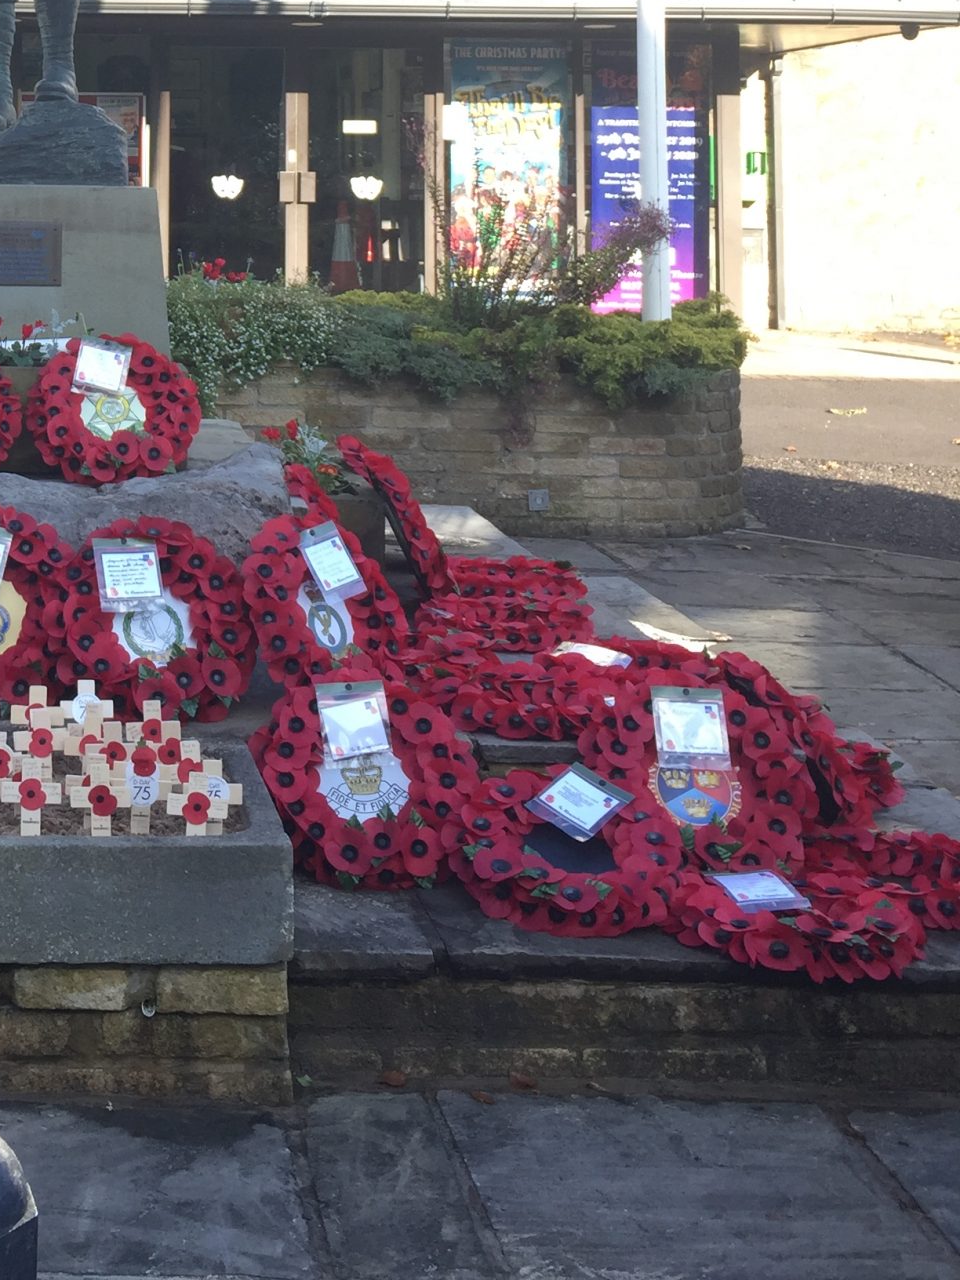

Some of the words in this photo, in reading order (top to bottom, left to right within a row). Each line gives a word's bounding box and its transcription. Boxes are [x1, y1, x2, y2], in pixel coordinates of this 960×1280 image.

[475, 47, 528, 58] CHRISTMAS
[133, 786, 151, 800] 75
[330, 790, 350, 807] FIDE
[355, 803, 367, 812] ET
[370, 786, 401, 811] FIDUCIA
